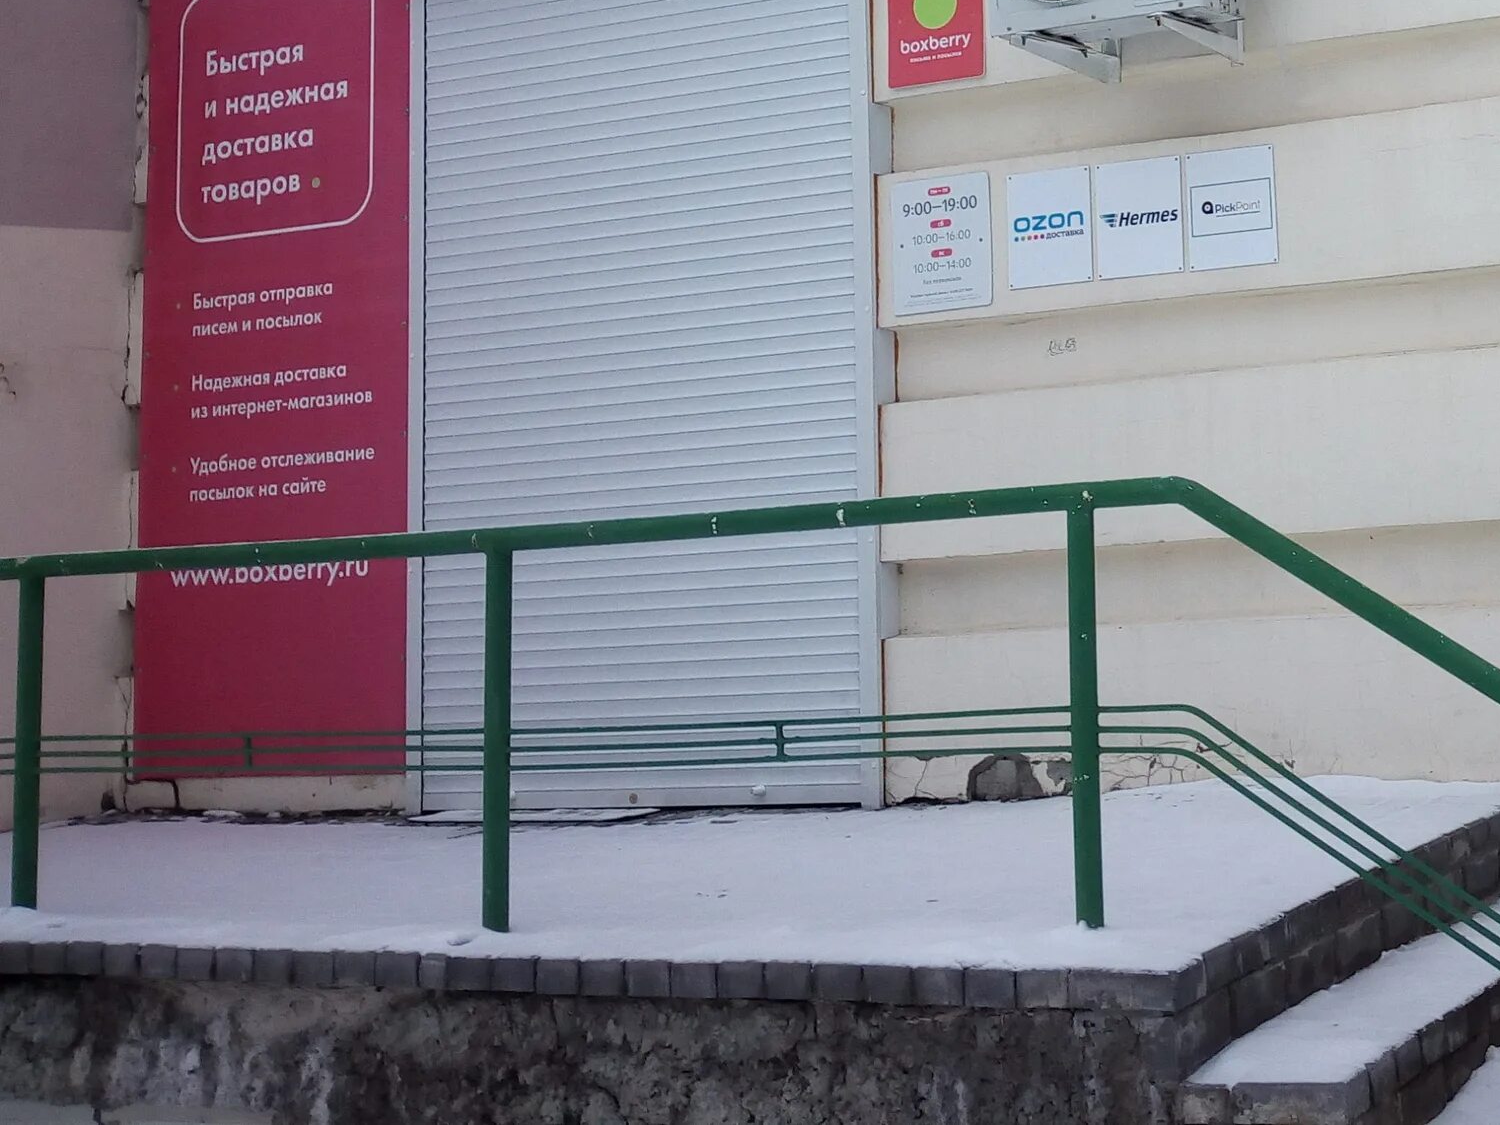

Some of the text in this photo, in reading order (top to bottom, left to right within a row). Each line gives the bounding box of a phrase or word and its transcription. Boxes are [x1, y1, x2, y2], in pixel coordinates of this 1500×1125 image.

[900, 33, 971, 54] boxberry
[206, 44, 304, 76] Быстрая
[205, 80, 348, 119] и надежная
[201, 128, 313, 165] доставка
[201, 174, 300, 205] товаров
[1119, 207, 1178, 227] Hermes
[1045, 227, 1084, 240] доставка
[193, 281, 333, 311] Быстрая отправка
[192, 311, 323, 337] писем и посылок
[191, 364, 347, 392] Надежная доставка
[191, 389, 373, 419] из интернет-магазинов
[190, 446, 375, 476] Удобное отслеживание
[189, 477, 327, 502] посылок на сайте
[170, 558, 369, 587] www.boxberry.ru
